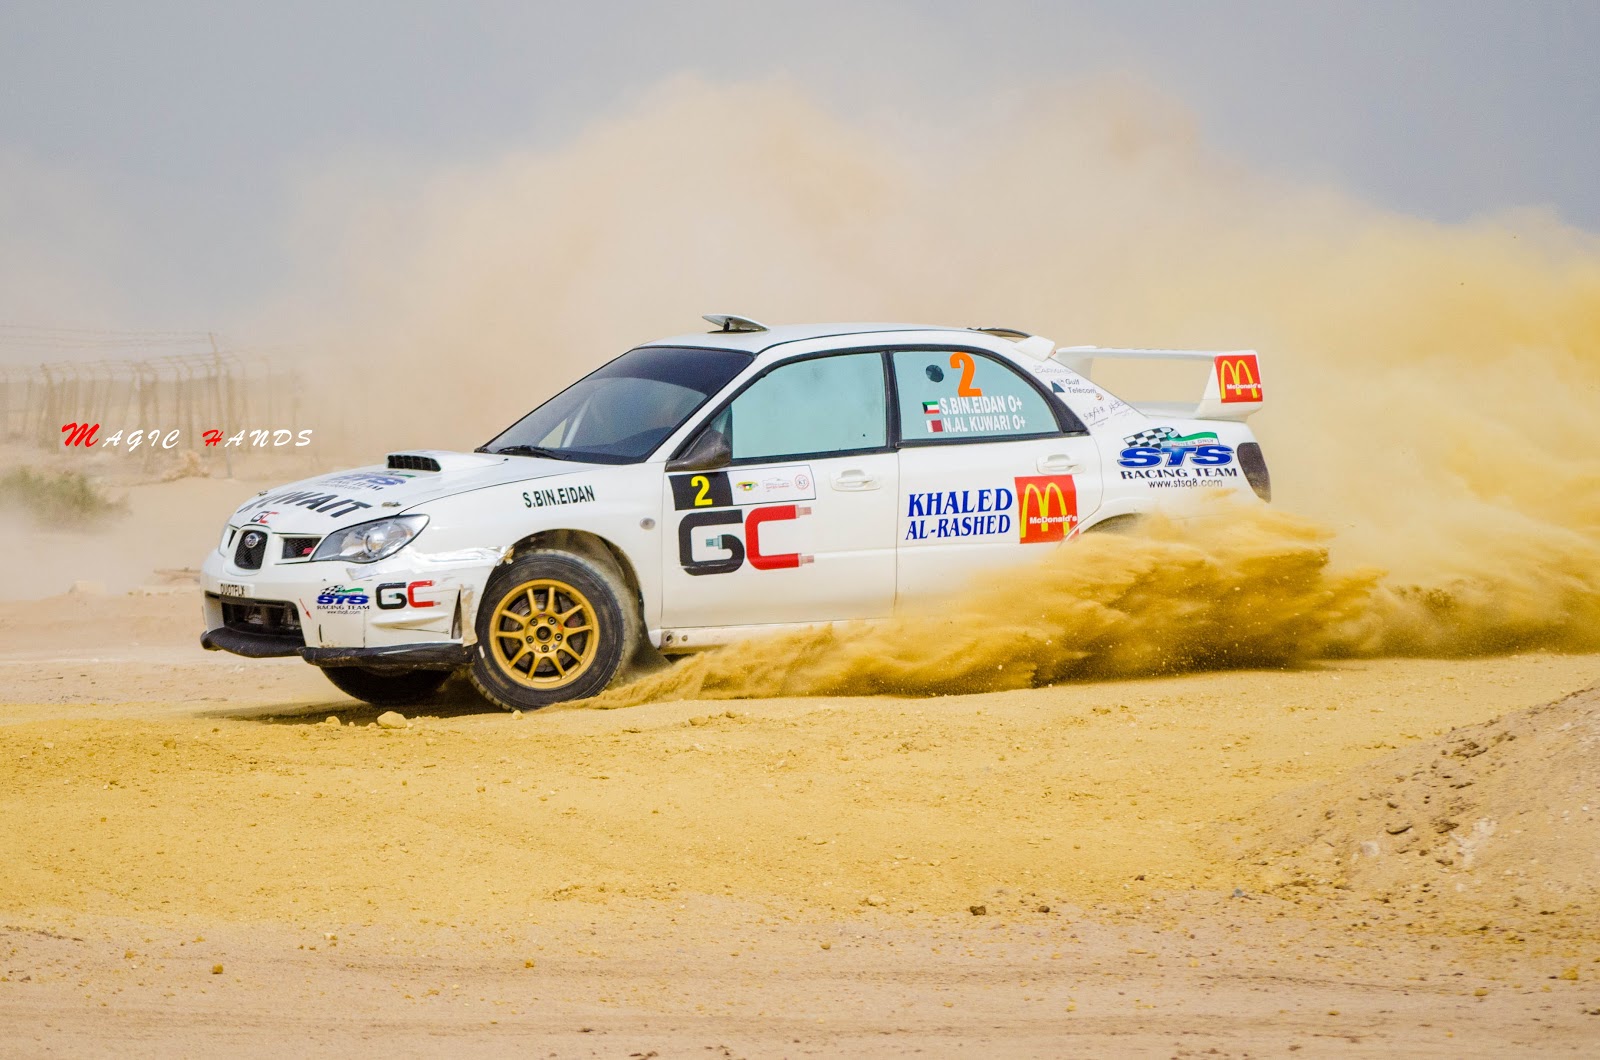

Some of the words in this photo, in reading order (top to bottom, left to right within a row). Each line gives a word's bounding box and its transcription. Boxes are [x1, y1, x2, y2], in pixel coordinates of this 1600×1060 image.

[949, 351, 983, 398] 2
[940, 396, 1007, 415] S.BIN.EIDAN
[943, 417, 969, 433] N.AL
[969, 415, 1011, 432] KUWARI
[1117, 445, 1235, 468] STS
[1120, 467, 1188, 480] RACING
[1192, 467, 1238, 477] TEAM
[1147, 478, 1223, 489] www.stsq8.com
[522, 485, 596, 508] S.BIN.EIDAN
[690, 475, 713, 507] 2
[907, 488, 1013, 517] KHALED
[905, 514, 1011, 541] AL-RASHED
[1029, 515, 1078, 525] McDonald's
[678, 505, 806, 576] GC
[316, 594, 370, 605] STS
[376, 580, 436, 610] GC
